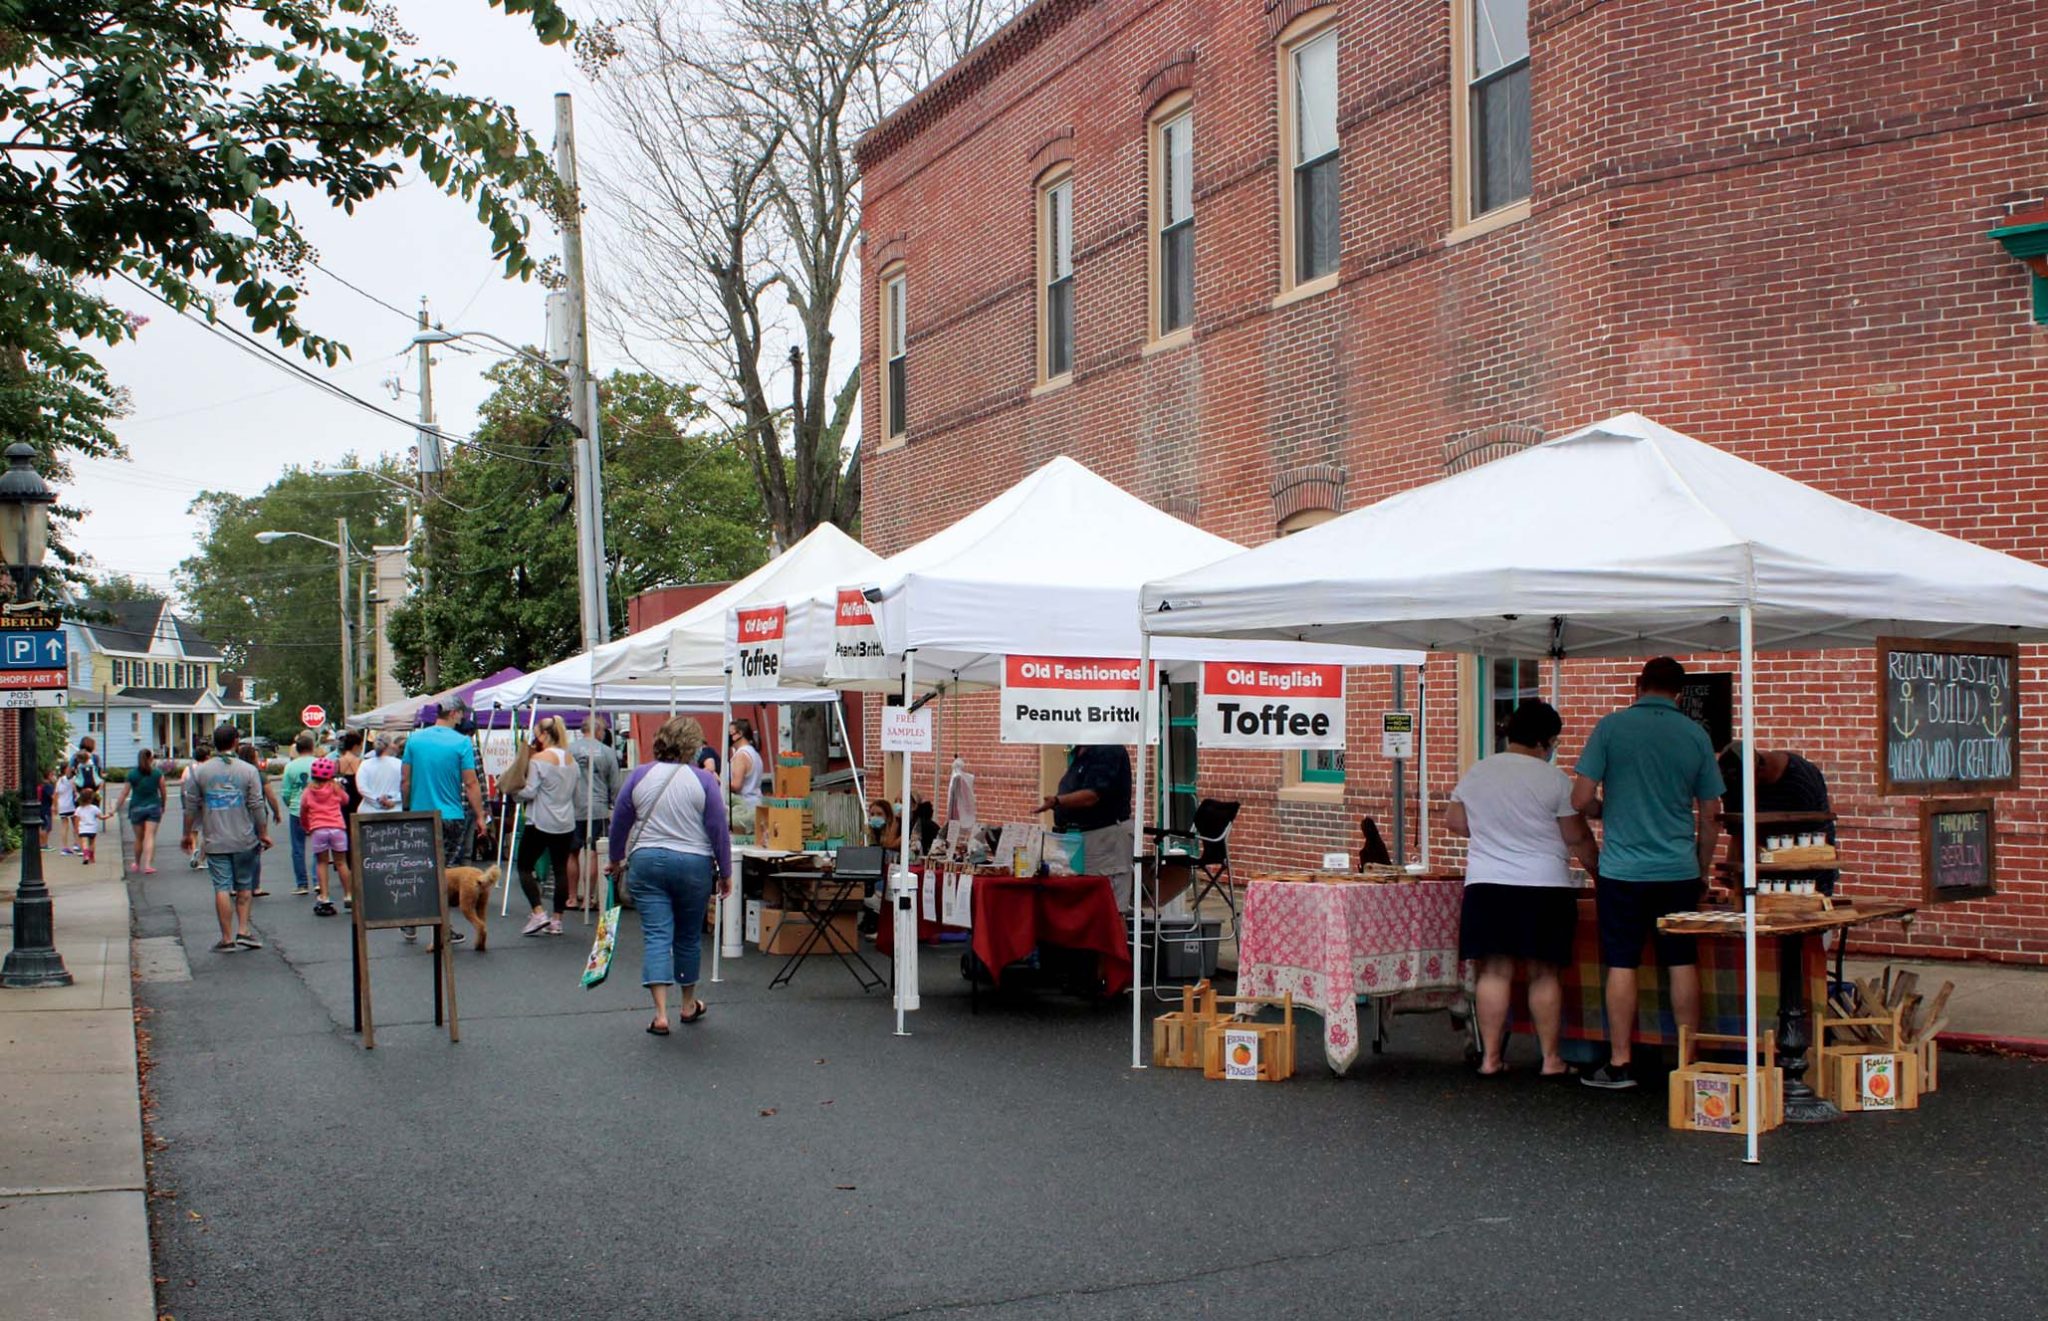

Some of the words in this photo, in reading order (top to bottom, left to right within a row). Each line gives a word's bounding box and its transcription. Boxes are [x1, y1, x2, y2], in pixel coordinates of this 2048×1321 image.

[0, 617, 54, 627] BERLIN
[14, 640, 30, 659] P
[835, 642, 860, 657] Peanut
[740, 649, 778, 677] Toffee
[33, 674, 51, 683] ART
[1021, 663, 1050, 679] Old
[1054, 664, 1141, 681] Fashioned
[1226, 669, 1255, 685] Old
[1259, 671, 1323, 690] English
[10, 691, 34, 699] POST
[6, 699, 37, 707] OFFICE
[303, 711, 325, 721] STOP
[896, 714, 917, 724] FREE
[1016, 705, 1082, 722] Peanut
[1217, 703, 1330, 736] Toffee
[887, 728, 926, 737] SAMPLES
[1889, 738, 1925, 780] ANCHOR
[1926, 737, 1955, 779] WOOD
[1957, 736, 2012, 779] CREATIONS
[361, 825, 400, 842] Pumpkin
[1952, 832, 1964, 844] IN
[401, 839, 431, 850] Brittle
[1941, 845, 1982, 868] BERLIN
